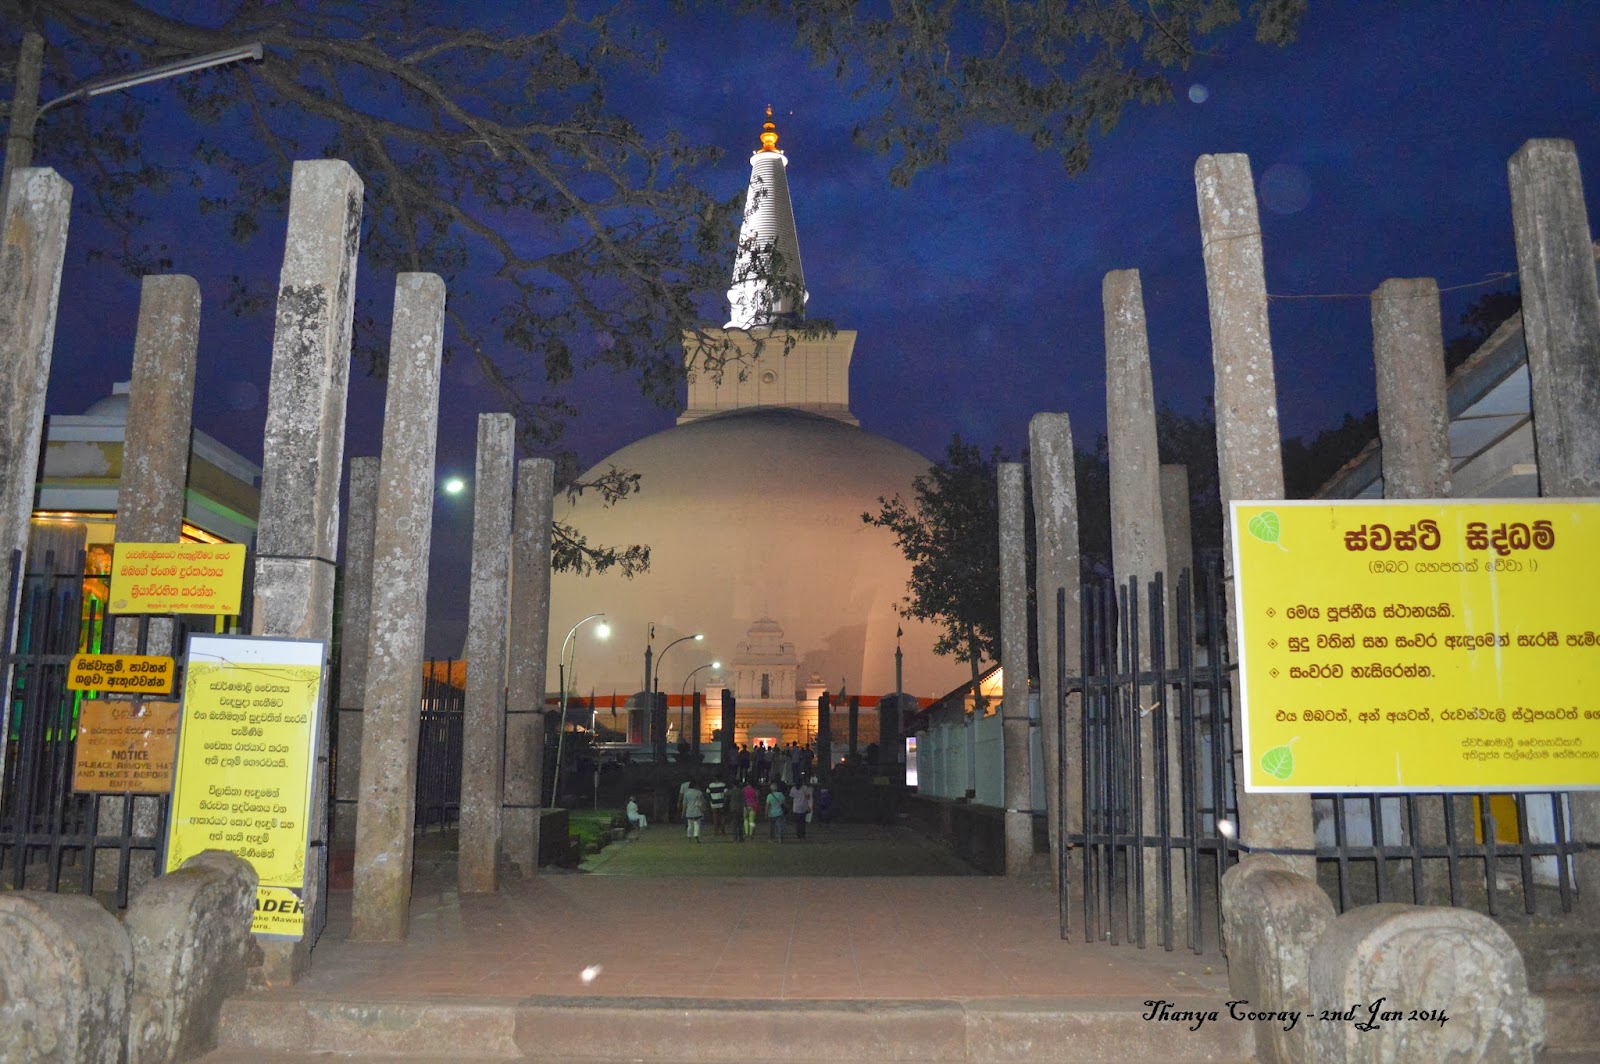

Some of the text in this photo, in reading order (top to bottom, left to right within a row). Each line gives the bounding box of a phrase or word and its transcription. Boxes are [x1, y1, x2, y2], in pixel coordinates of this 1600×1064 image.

[151, 566, 177, 577] ජංගම
[1369, 560, 1408, 574] (ඔබට
[1415, 559, 1478, 573] යහපතක්
[1286, 603, 1455, 622] මෙය පූජනීය ස්ථානයකි.
[1288, 637, 1310, 652] සුදු
[1317, 633, 1355, 648] වතින්
[1363, 636, 1388, 648] සහ
[1395, 633, 1437, 648] සංවර
[1517, 632, 1559, 647] සැරසී
[1290, 663, 1435, 679] සංවරව හැසිරෙන්න.
[75, 674, 103, 685] ගලවා
[1275, 710, 1297, 721] එය
[1303, 708, 1351, 723] ඔබටත්,
[1358, 708, 1380, 723] අන්
[1386, 708, 1434, 723] අයටත්,
[111, 750, 149, 760] NOTICE
